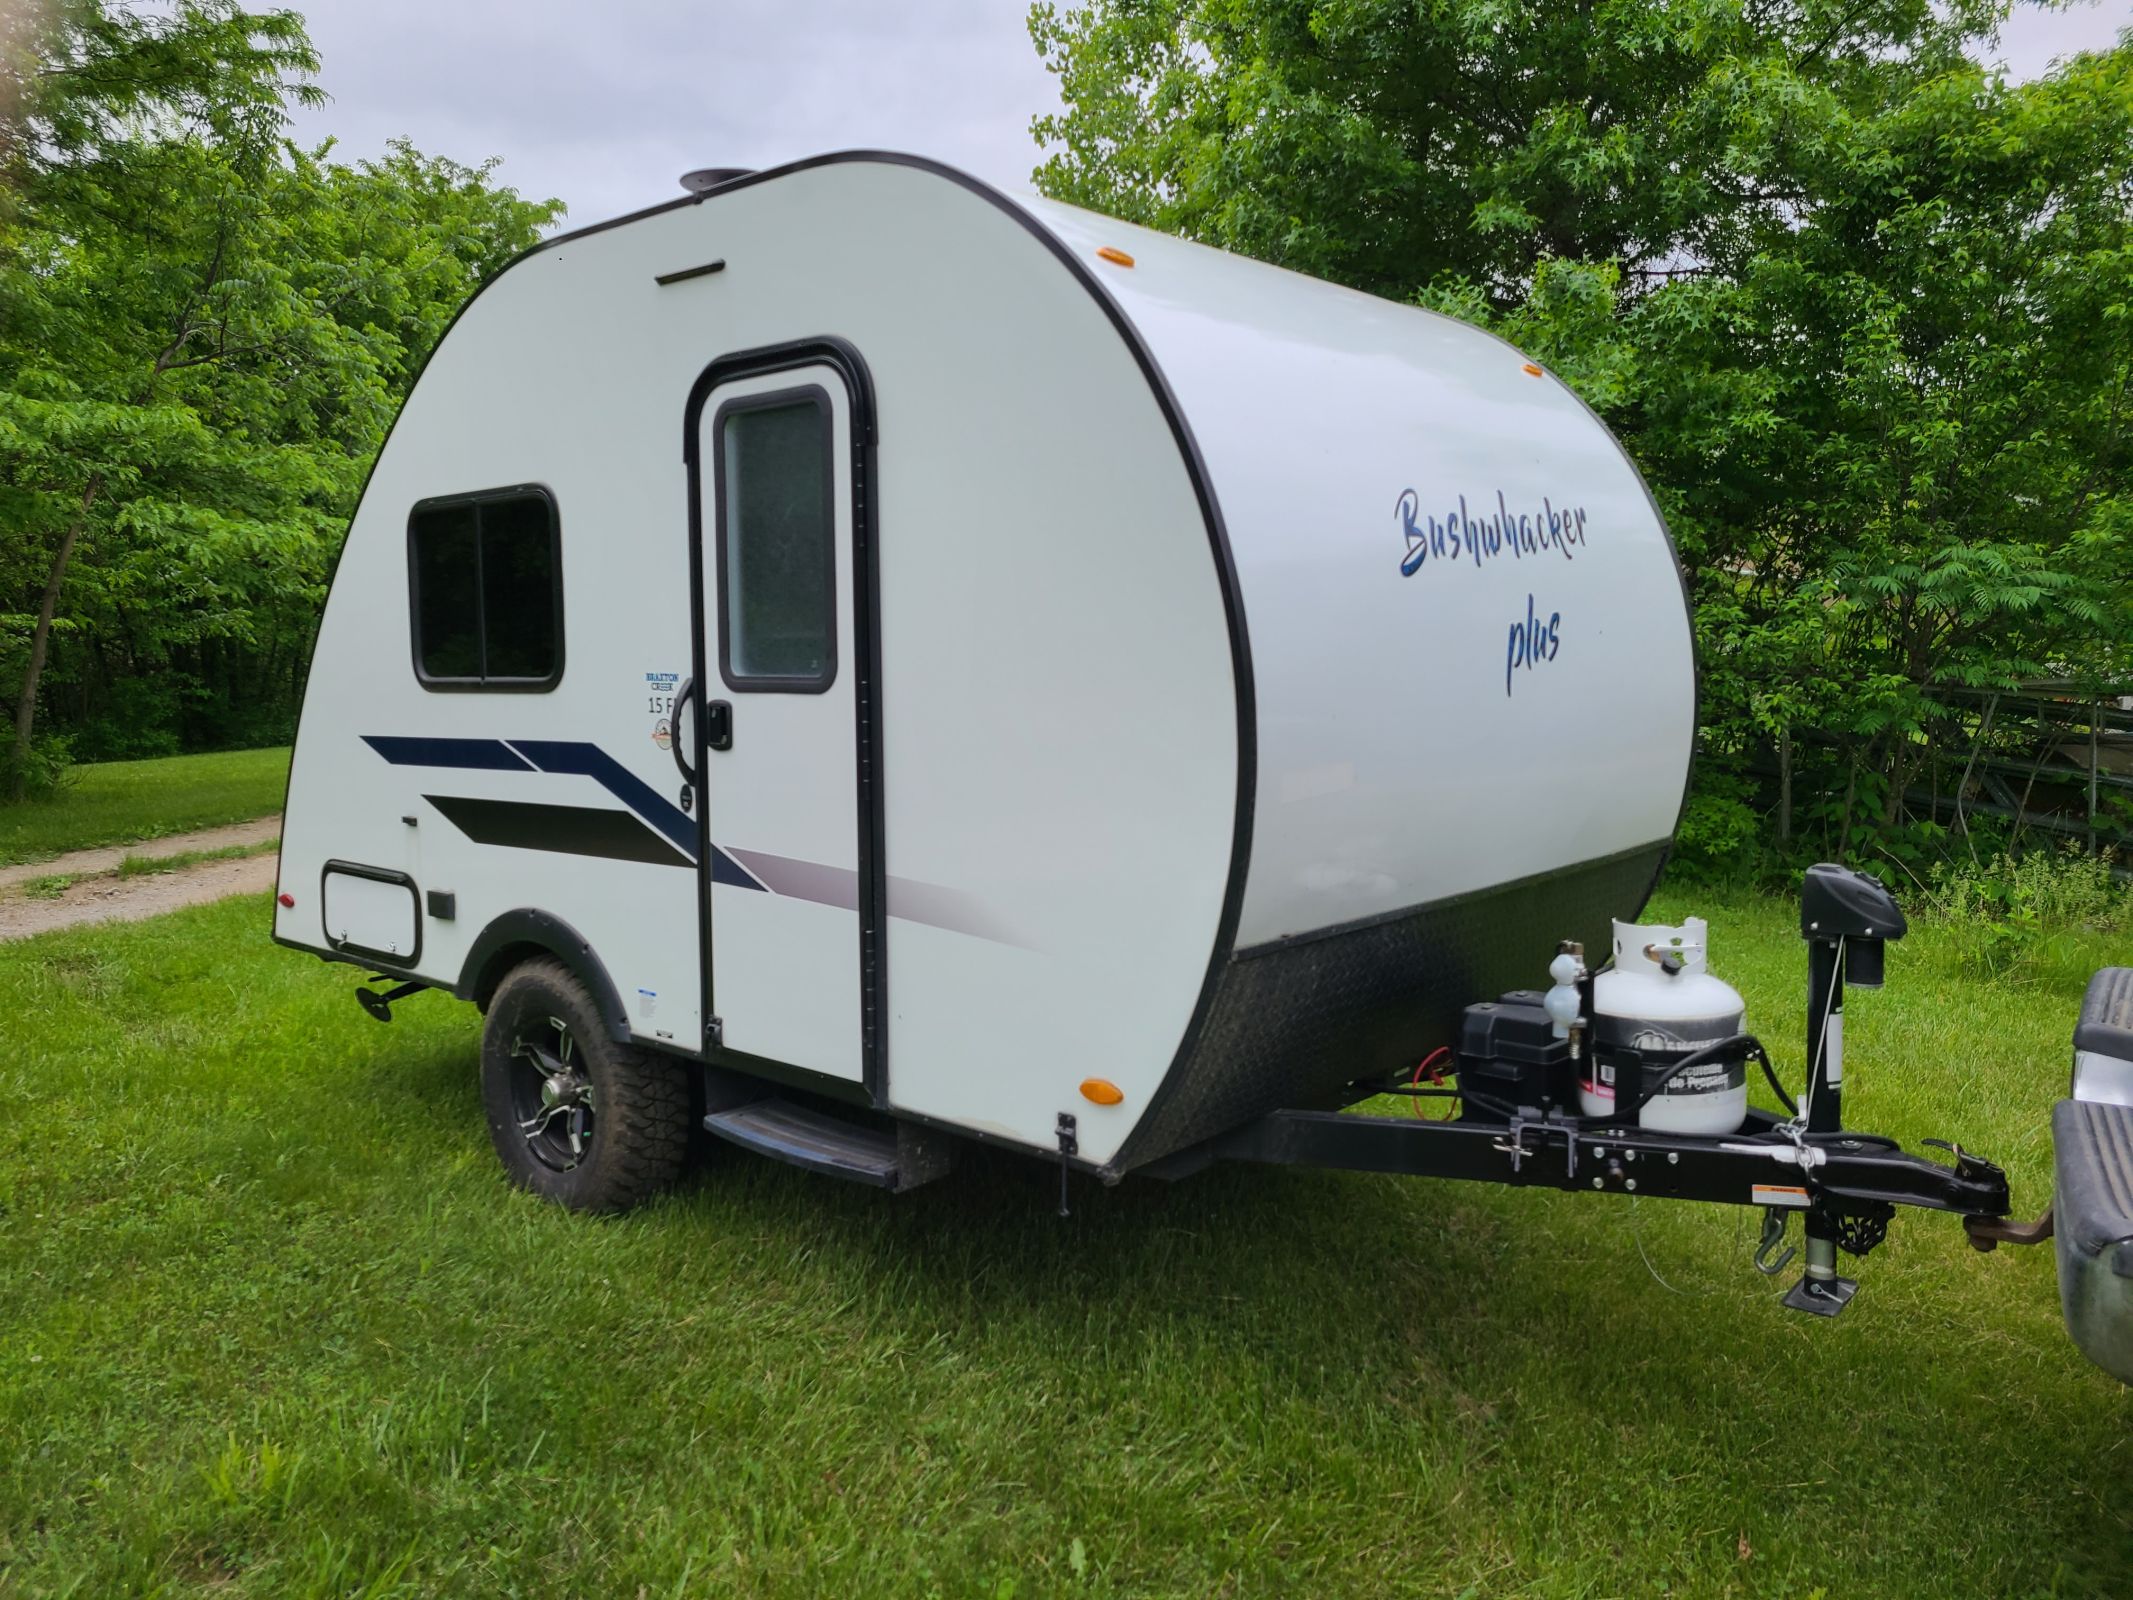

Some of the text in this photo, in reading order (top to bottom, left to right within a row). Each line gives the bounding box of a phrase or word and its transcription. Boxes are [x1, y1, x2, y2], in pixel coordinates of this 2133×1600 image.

[1395, 488, 1587, 577] Bushwhacker
[1507, 593, 1560, 698] plus
[649, 697, 663, 713] 15
